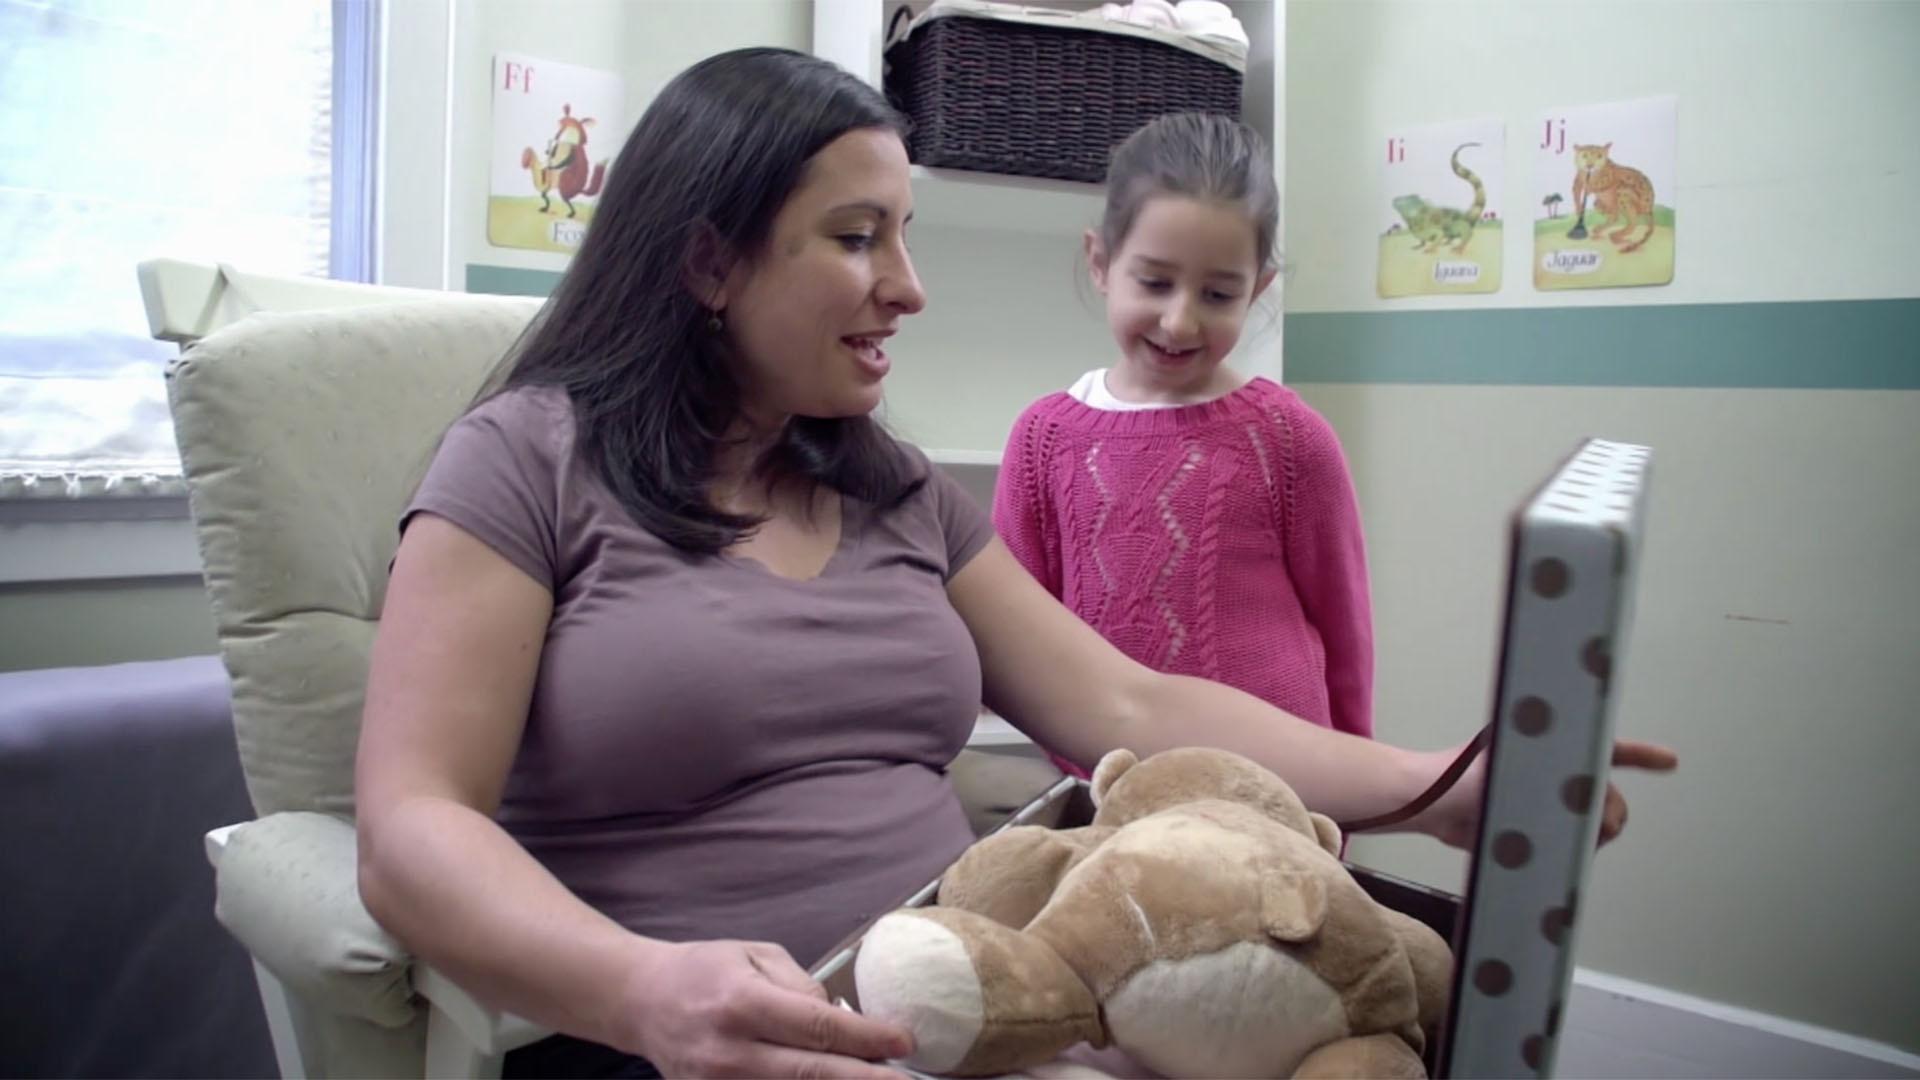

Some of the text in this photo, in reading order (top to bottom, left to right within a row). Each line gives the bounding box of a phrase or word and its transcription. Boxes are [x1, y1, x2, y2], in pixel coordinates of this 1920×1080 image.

[504, 61, 535, 93] Ff
[1540, 118, 1566, 154] Jj
[1547, 250, 1597, 272] Jaguar
